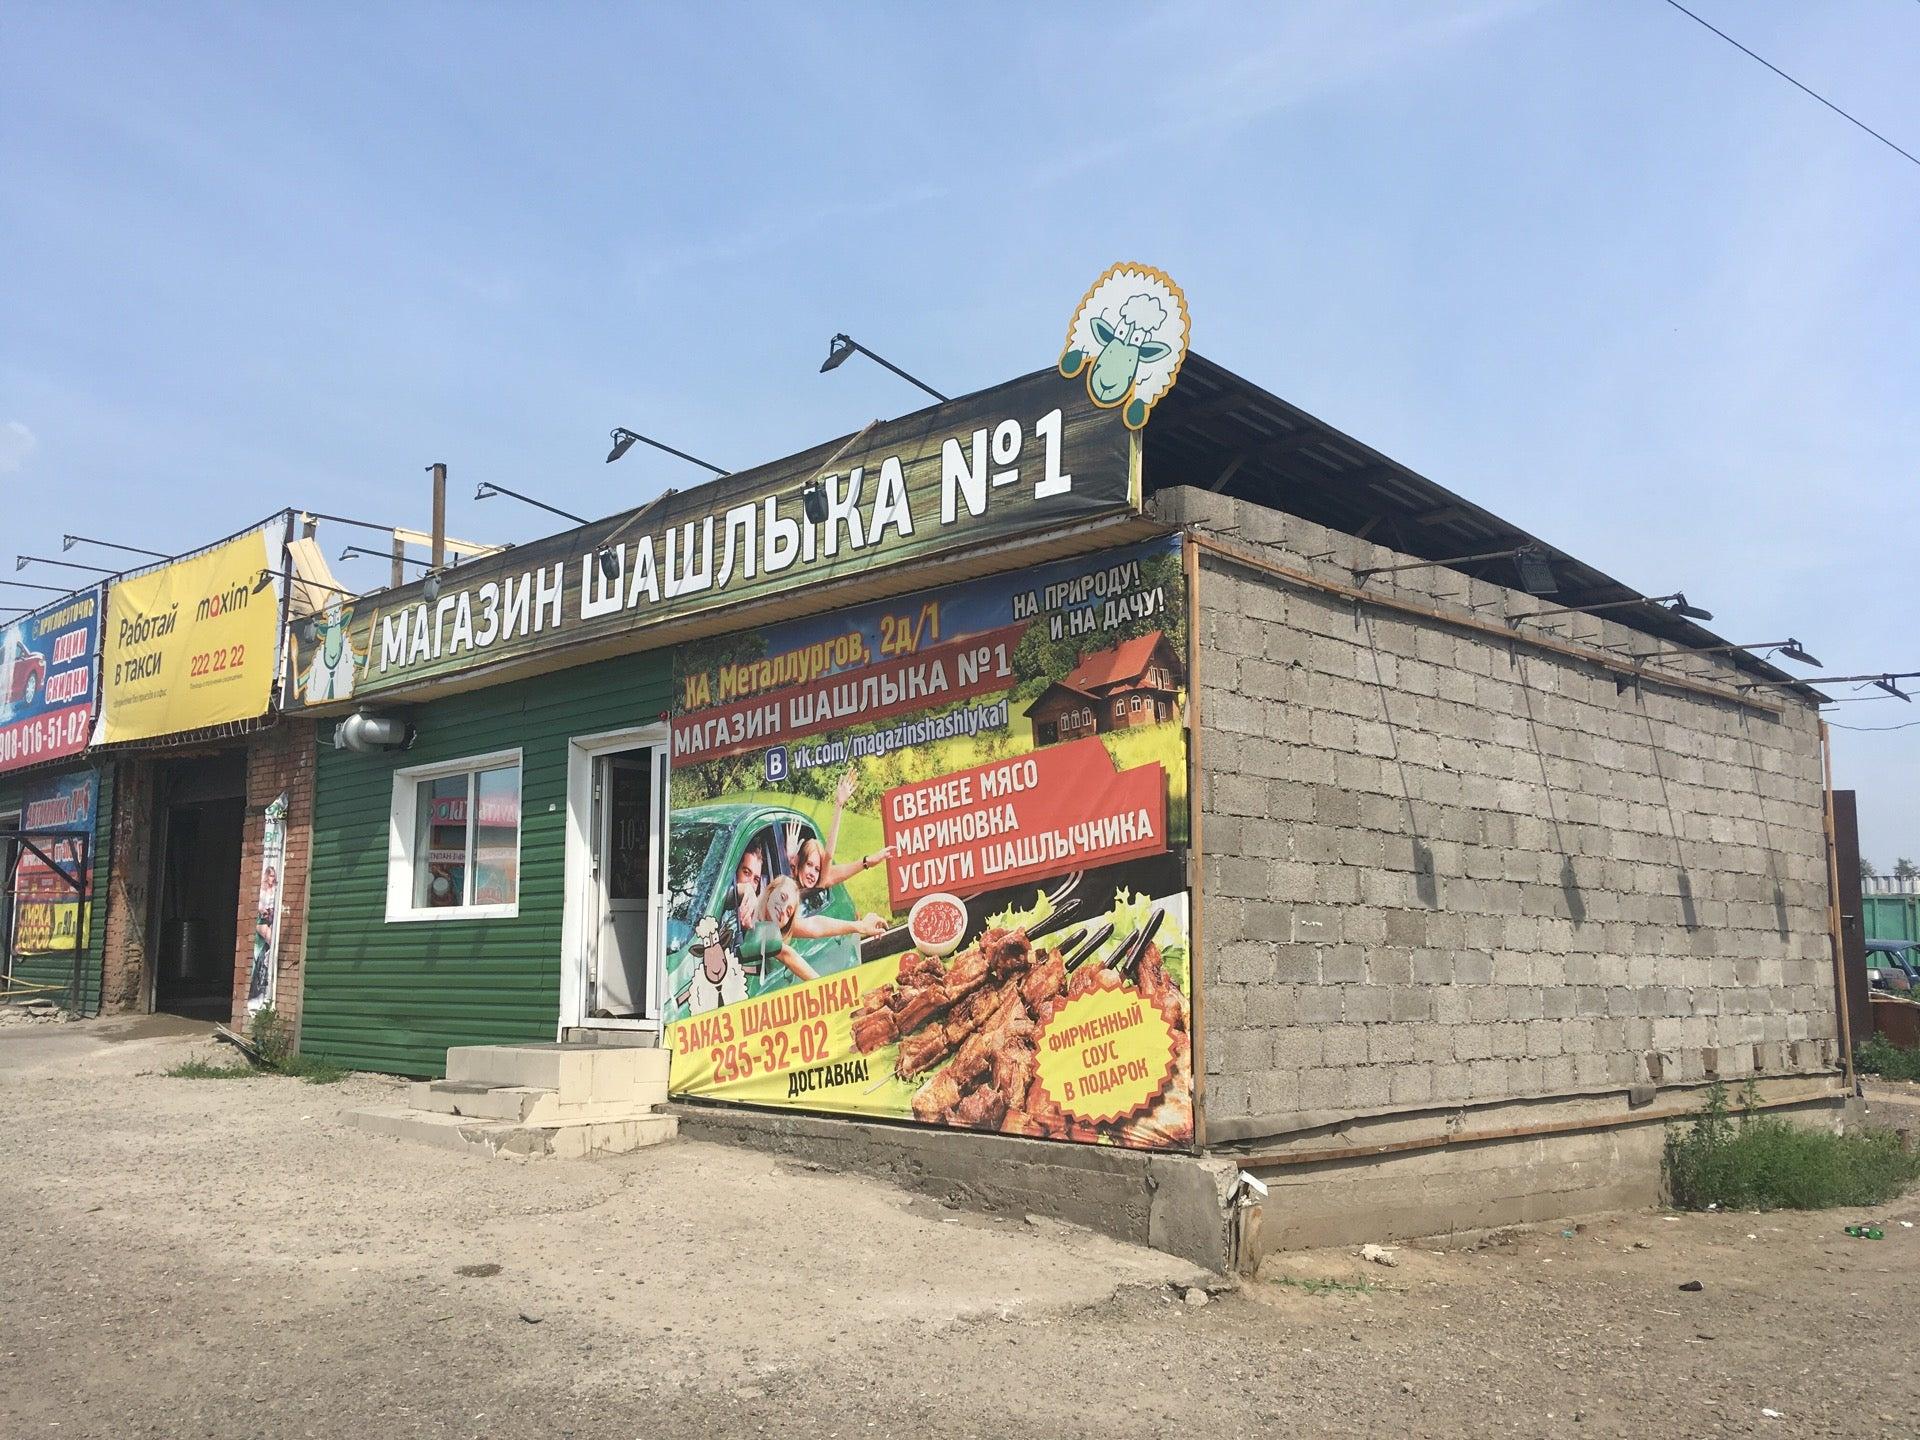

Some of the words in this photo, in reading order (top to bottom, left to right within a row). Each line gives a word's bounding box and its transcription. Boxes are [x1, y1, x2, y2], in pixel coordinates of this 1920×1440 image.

[380, 561, 564, 673] МАГАЗИН
[581, 455, 915, 620] ШАШЛЫКА
[940, 408, 1072, 526] №1
[195, 581, 250, 623] maxim
[1013, 594, 1040, 621] НА
[1044, 560, 1142, 612] ПРИРОДУ!
[1050, 614, 1063, 641] И
[1068, 603, 1096, 637] НА
[1103, 586, 1165, 632] ДАЧУ!
[52, 627, 88, 665] АКЦИИ
[118, 602, 179, 650] Работай
[114, 660, 122, 687] в
[124, 651, 163, 684] такси
[190, 653, 210, 678] 222
[212, 649, 227, 673] 22
[230, 644, 245, 669] 22
[684, 672, 711, 710] НА
[718, 631, 871, 699] Металлургов,
[879, 601, 942, 656] 2д/1
[45, 666, 88, 704] СКИДКИ
[674, 702, 782, 758] МАГАЗИН
[789, 658, 949, 729] ШАШЛЫКА
[957, 643, 1012, 687] №1
[794, 699, 1009, 769] vk.com/magazinshashlyka1
[892, 776, 974, 823] СВЕЖЕЕ
[979, 759, 1039, 800] МЯСО
[895, 803, 1020, 858] МАРИНОВКА
[898, 850, 976, 893] УСЛУГИ
[982, 808, 1154, 875] ШАШЛЫЧНИКА
[677, 1012, 735, 1056] ЗАКАЗ
[740, 975, 861, 1038] ШАШЛЫКА!
[1048, 1001, 1144, 1052] ФИРМЕННЫЙ
[711, 1020, 830, 1085] 295-32-02
[788, 1058, 869, 1099] ДОСТАВКА!
[1063, 1081, 1075, 1102] В
[1078, 1057, 1149, 1095] ПОДАРОК
[1081, 1040, 1119, 1069] СОУС
